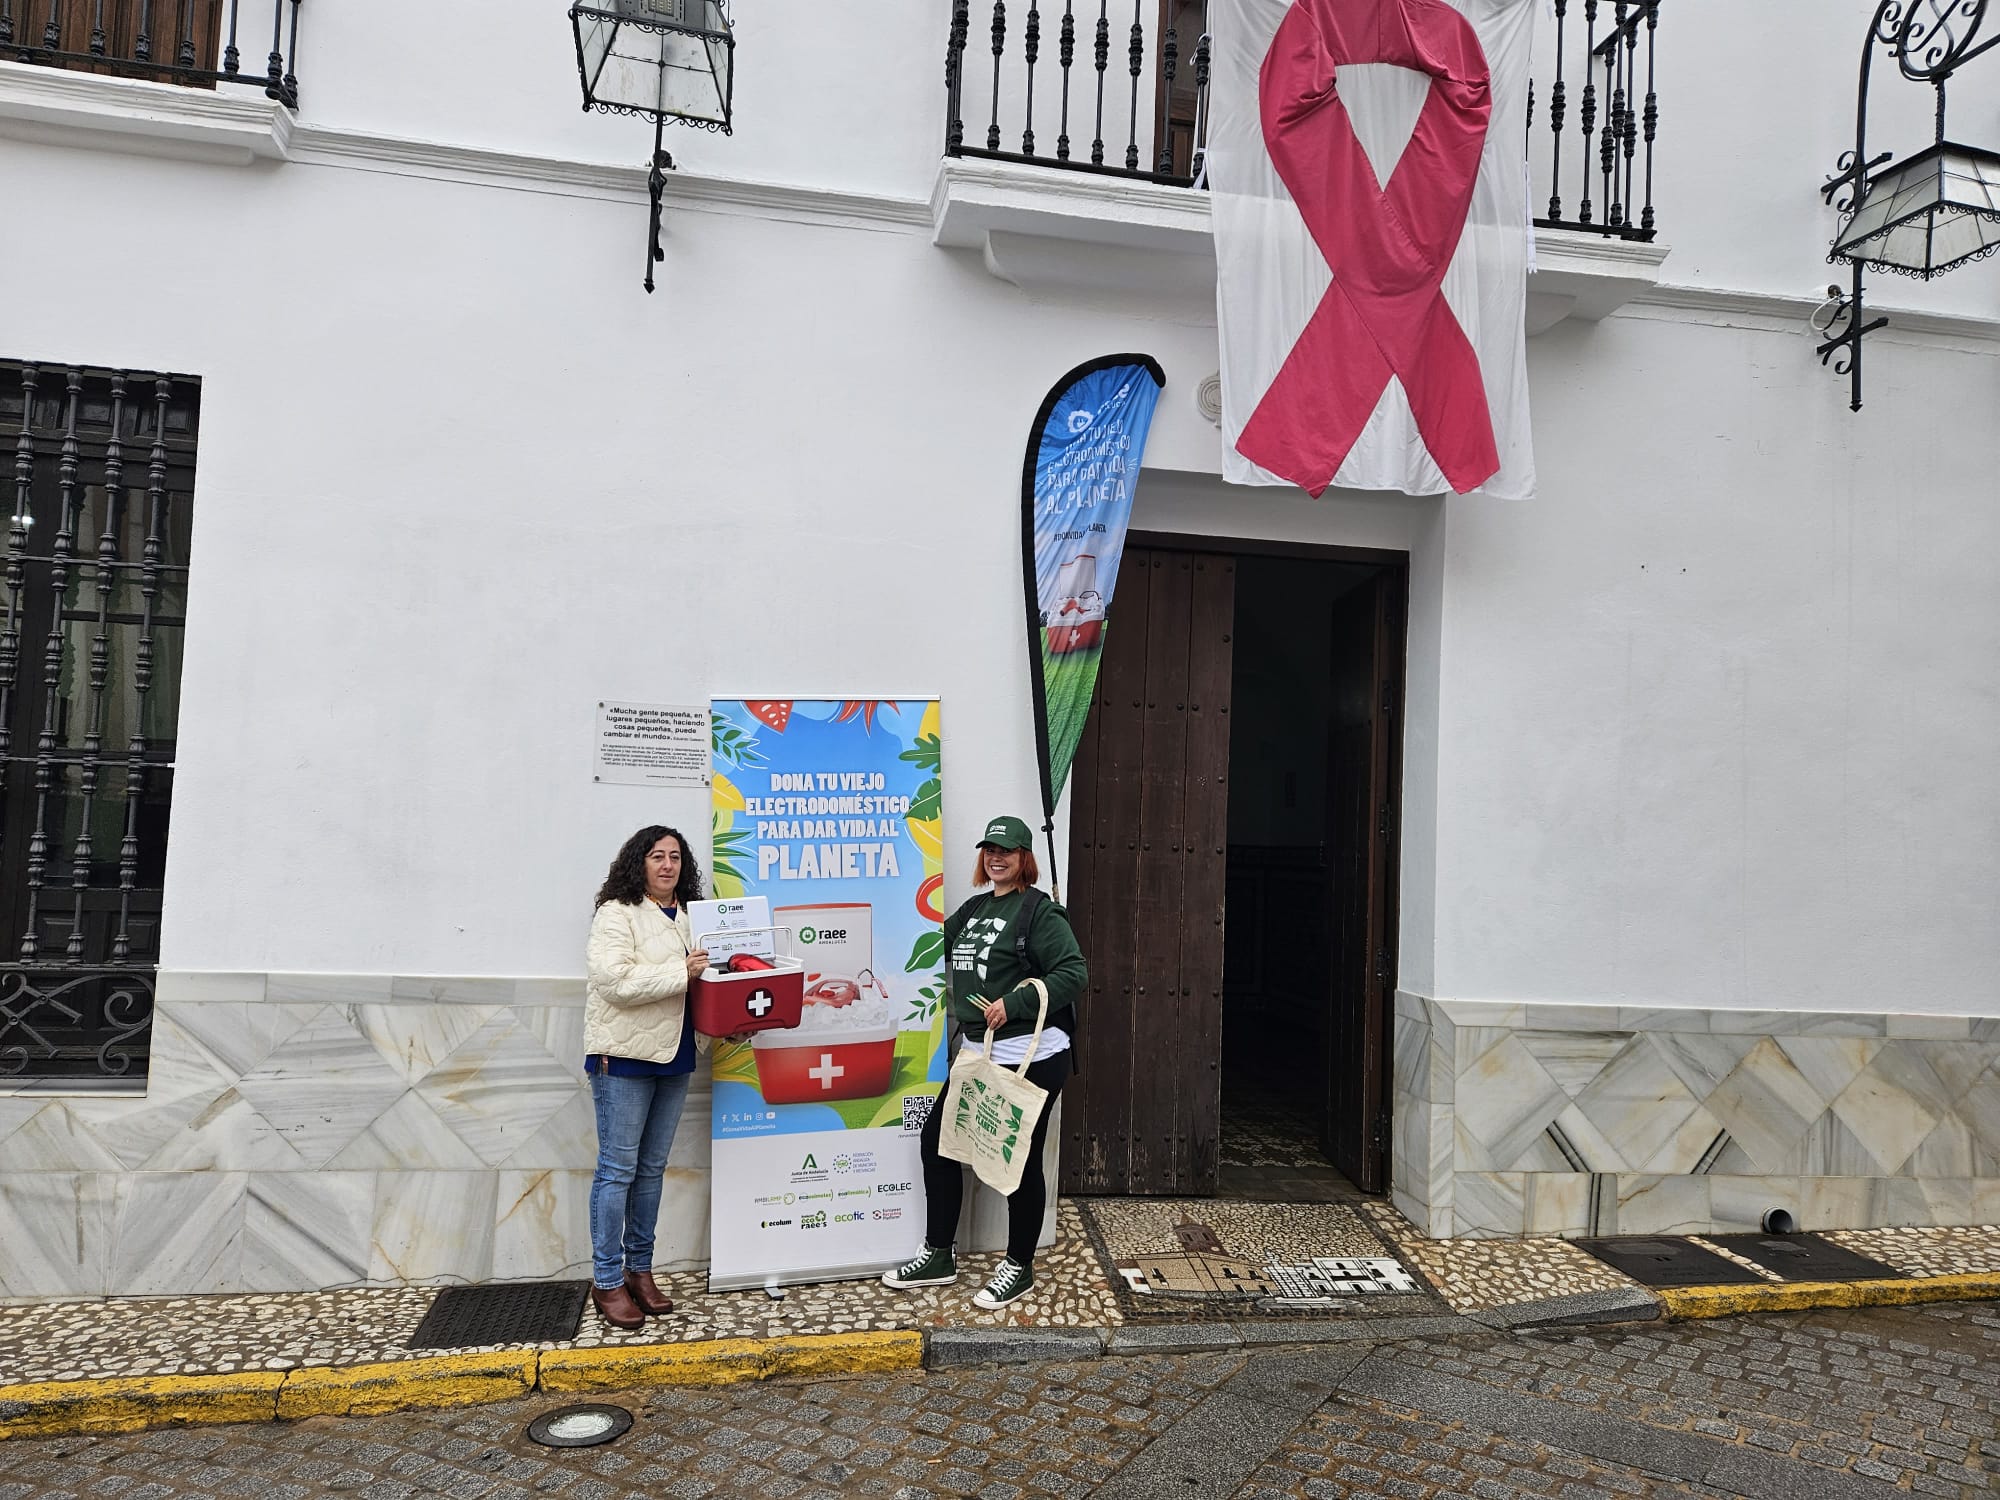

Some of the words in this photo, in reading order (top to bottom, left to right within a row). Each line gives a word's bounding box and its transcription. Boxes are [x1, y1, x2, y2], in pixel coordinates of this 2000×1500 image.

[1044, 492, 1063, 514] AL
[1066, 477, 1126, 509] PLANETA
[609, 707, 638, 715] «Mucha
[660, 711, 692, 720] pequeña,
[606, 715, 633, 723] lugares
[634, 717, 671, 726] pequeños,
[673, 719, 705, 727] haciendo
[637, 725, 673, 733] pequeñas,
[771, 773, 814, 792] DONA
[817, 773, 838, 791] TU
[840, 772, 885, 791] VIEJO
[745, 794, 910, 816] ELECTRODOMÉSTICO
[757, 820, 803, 839] PARA
[803, 820, 836, 838] DAR
[839, 819, 878, 838] VIDA
[877, 819, 899, 837] AL
[758, 843, 901, 881] PLANETA
[819, 929, 847, 940] raee
[877, 1182, 912, 1193] ECOLEC
[834, 1211, 865, 1222] ecotic
[768, 1219, 792, 1227] ecolum
